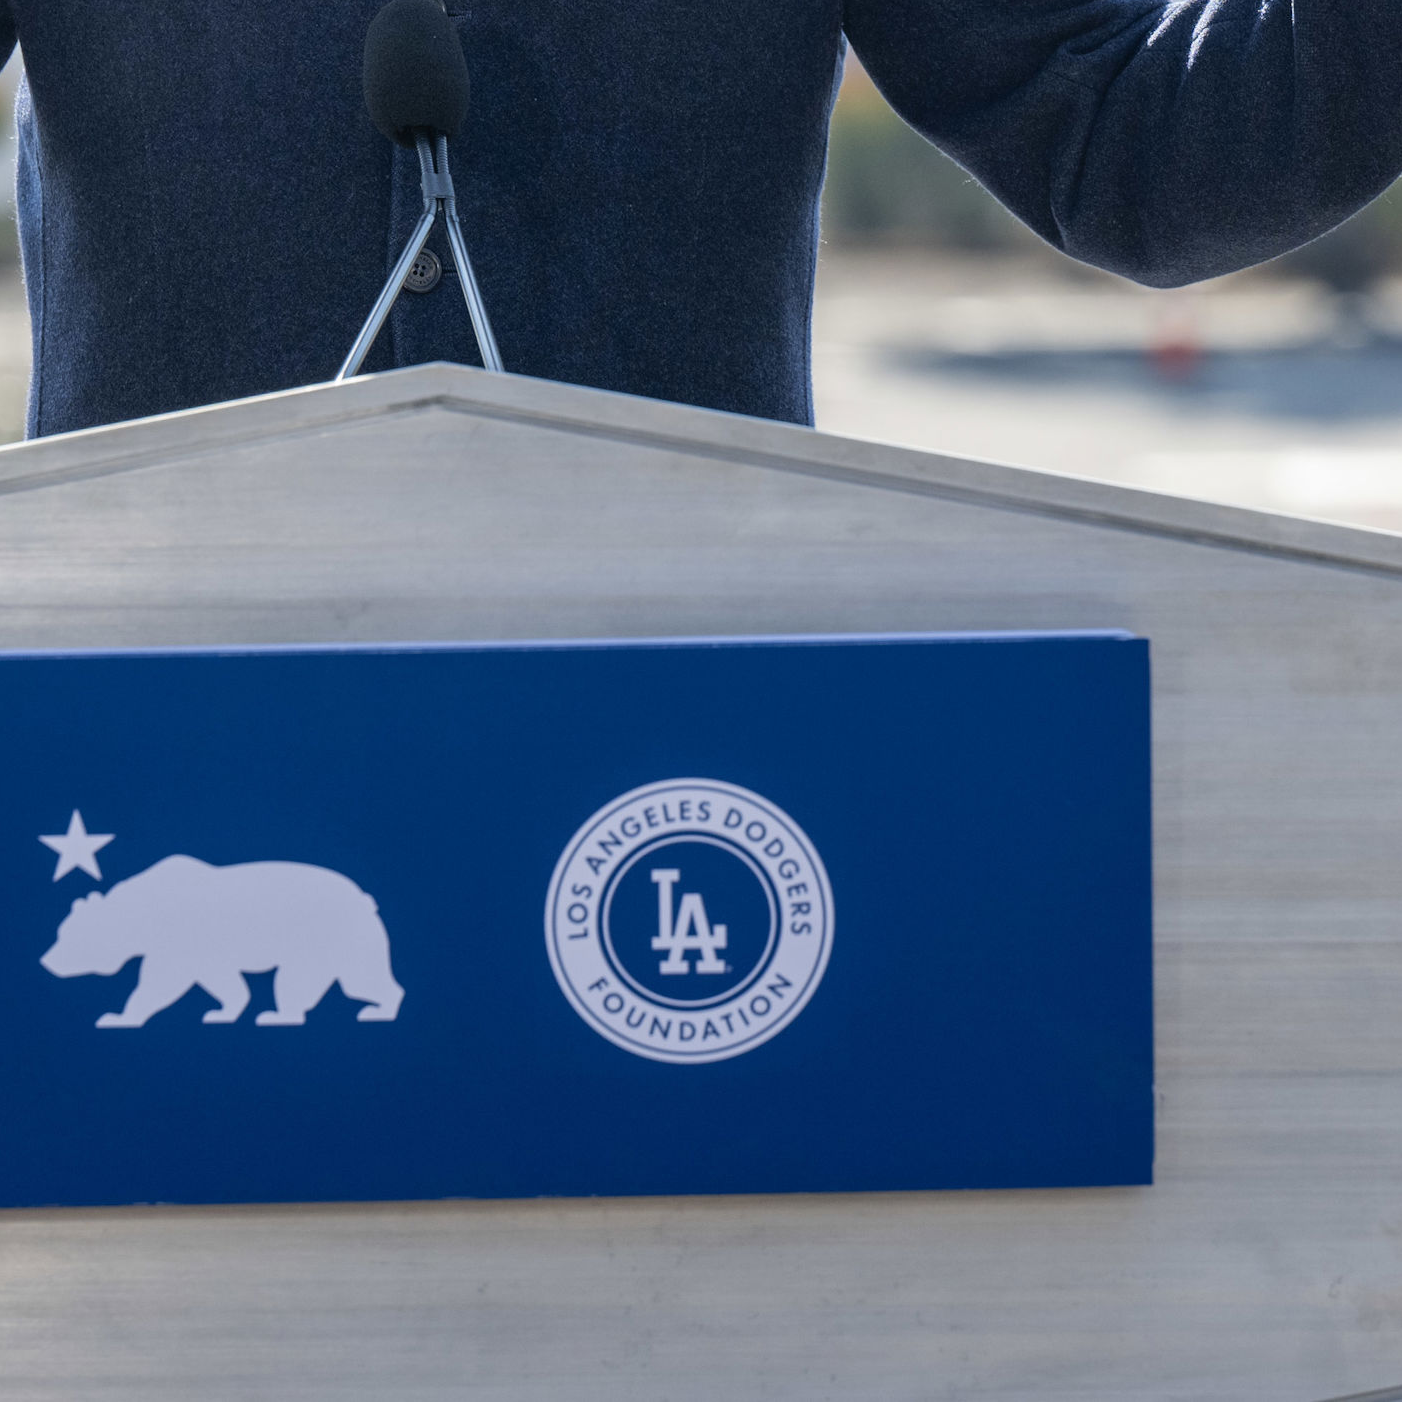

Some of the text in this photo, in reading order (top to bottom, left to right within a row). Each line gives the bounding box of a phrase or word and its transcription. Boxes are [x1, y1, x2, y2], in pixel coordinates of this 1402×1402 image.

[567, 800, 812, 940] LOS ANGELES DODGERS
[651, 868, 727, 975] LA
[587, 972, 794, 1042] FOUNDATION
